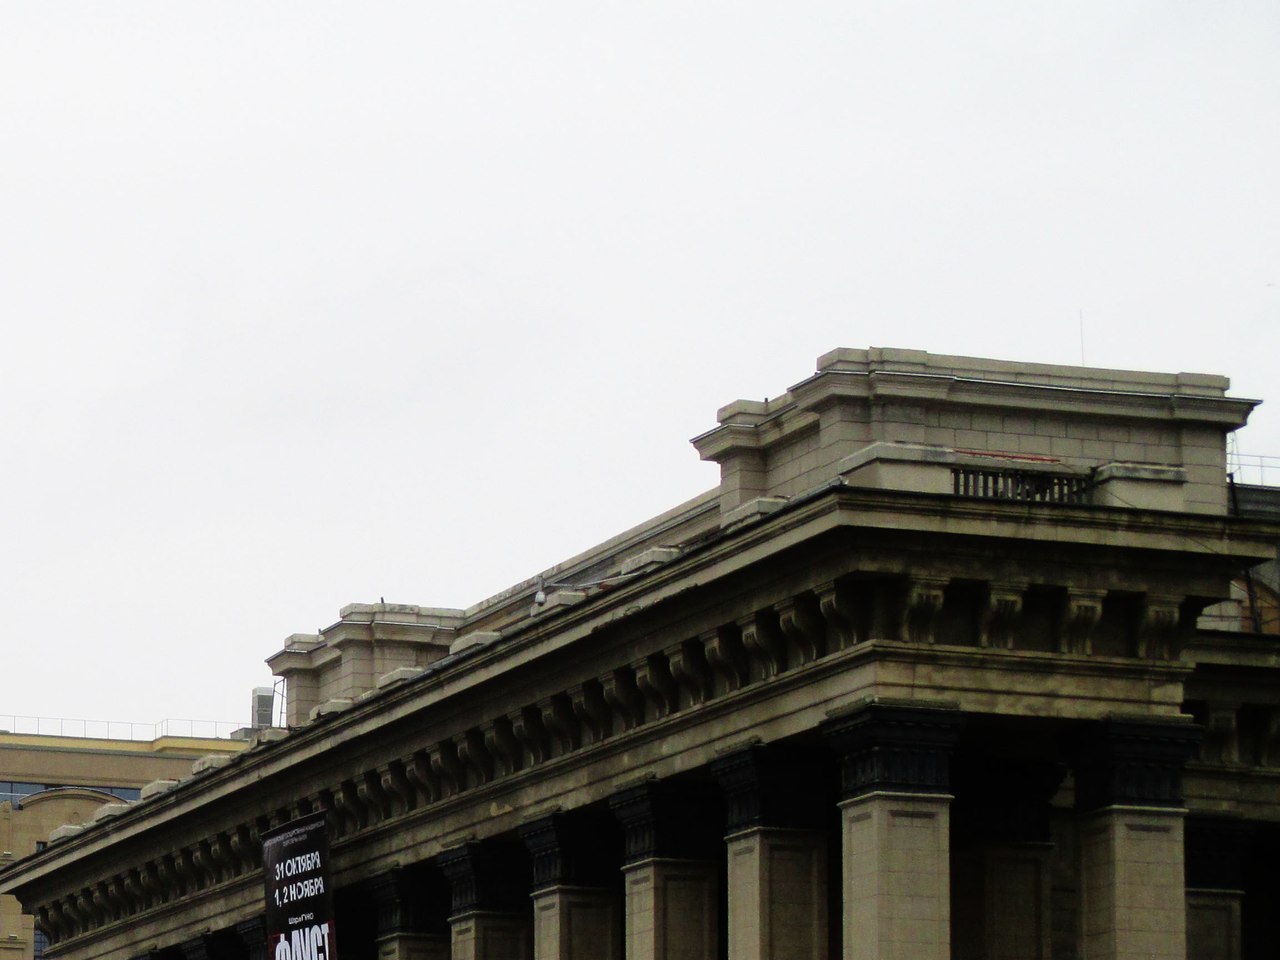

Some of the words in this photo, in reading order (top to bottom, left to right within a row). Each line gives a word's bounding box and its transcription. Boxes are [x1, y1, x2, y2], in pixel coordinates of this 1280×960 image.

[275, 862, 284, 880] 31
[285, 851, 321, 877] ОКТЯБРЯ
[283, 886, 289, 904] 2
[289, 876, 324, 902] НОЯБРЯ
